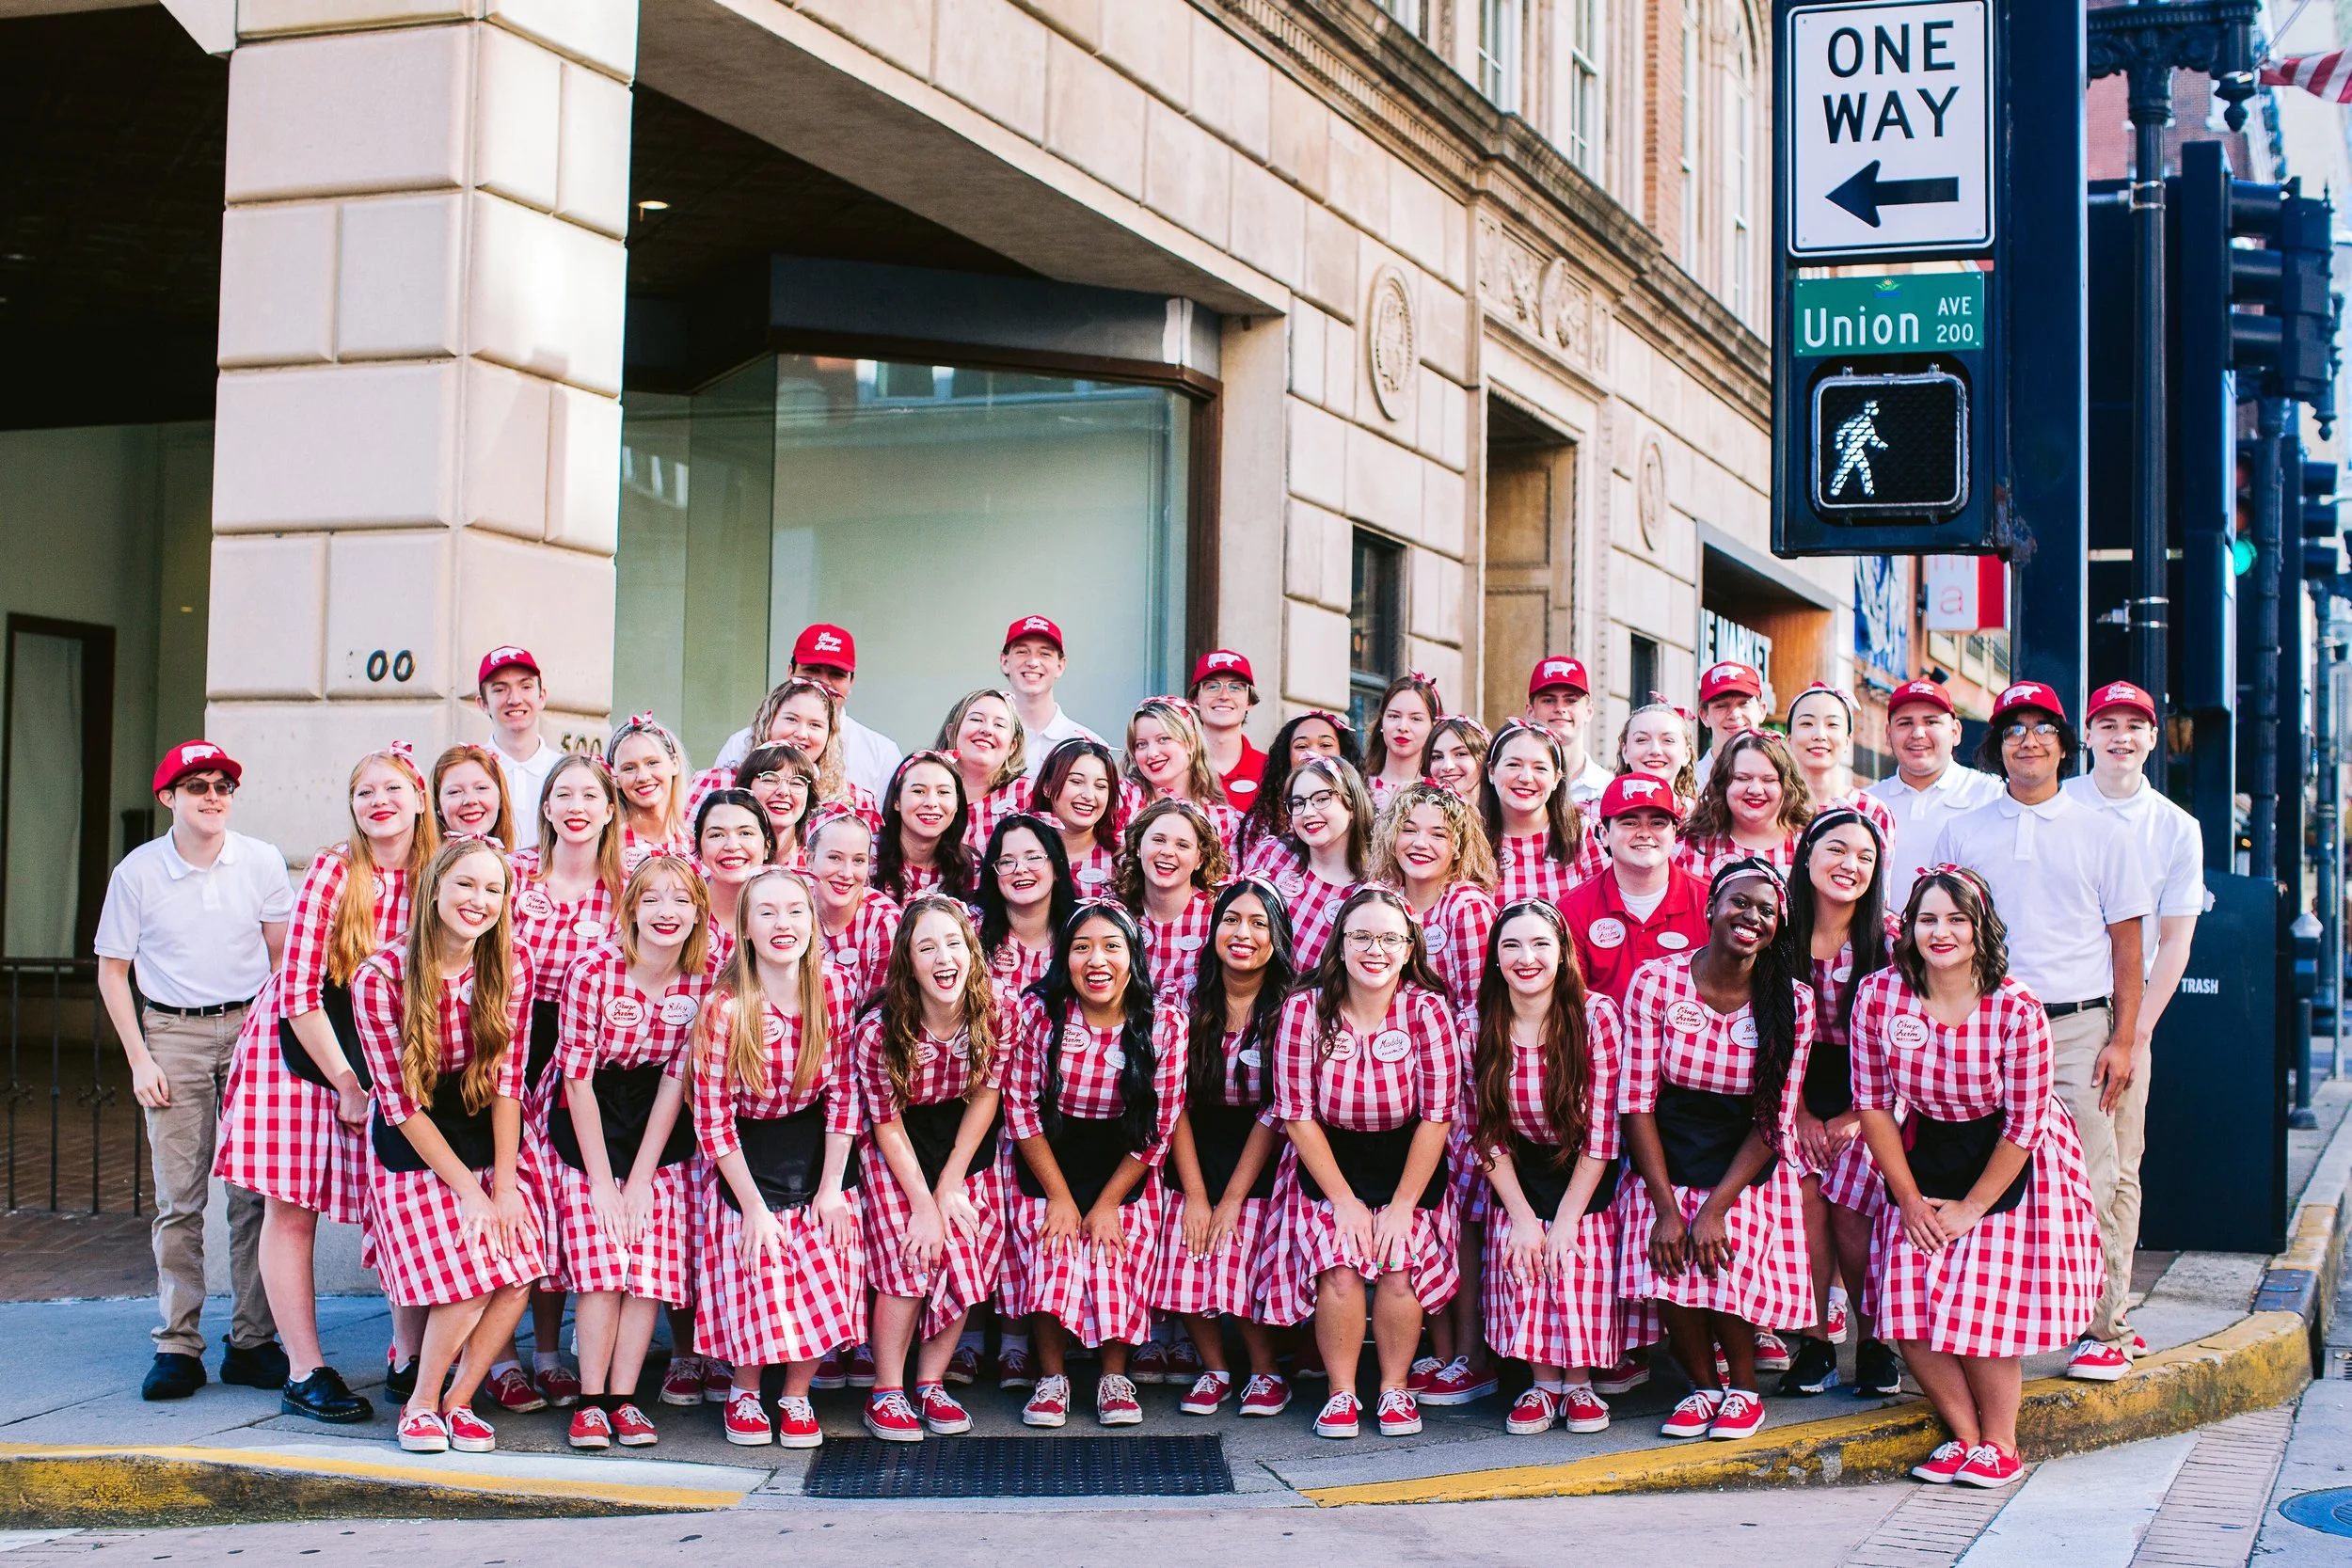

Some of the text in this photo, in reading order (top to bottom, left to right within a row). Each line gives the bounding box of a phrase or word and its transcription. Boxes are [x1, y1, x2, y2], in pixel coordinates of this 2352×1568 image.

[1827, 20, 1956, 78] ONE
[1822, 86, 1961, 144] WAY
[1937, 296, 1972, 317] AVE
[1804, 306, 1919, 348] Union
[1937, 324, 1974, 343] 200
[366, 649, 417, 682] 00
[1716, 614, 1772, 685] MARKET
[2181, 977, 2219, 994] TRASH
